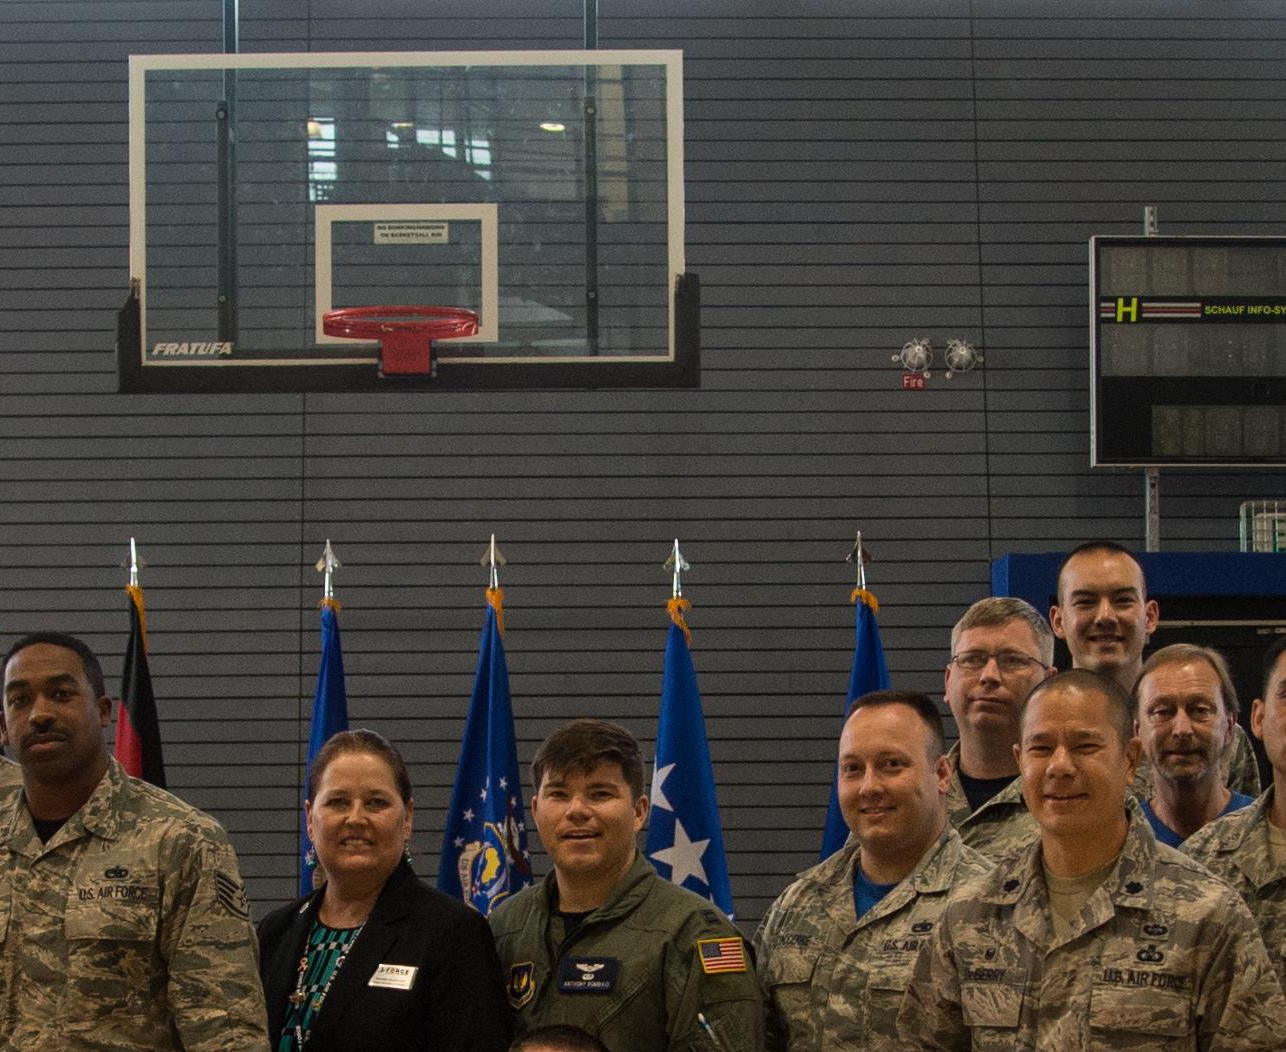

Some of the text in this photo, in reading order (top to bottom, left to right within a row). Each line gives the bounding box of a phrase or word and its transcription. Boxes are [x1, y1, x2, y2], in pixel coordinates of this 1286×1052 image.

[1116, 298, 1138, 322] H
[1205, 305, 1246, 316] SCHAUF
[152, 342, 233, 356] FRATUFA
[903, 376, 924, 388] Fire
[78, 886, 148, 900] U.S. AIR FORCE
[1127, 969, 1150, 986] AIR
